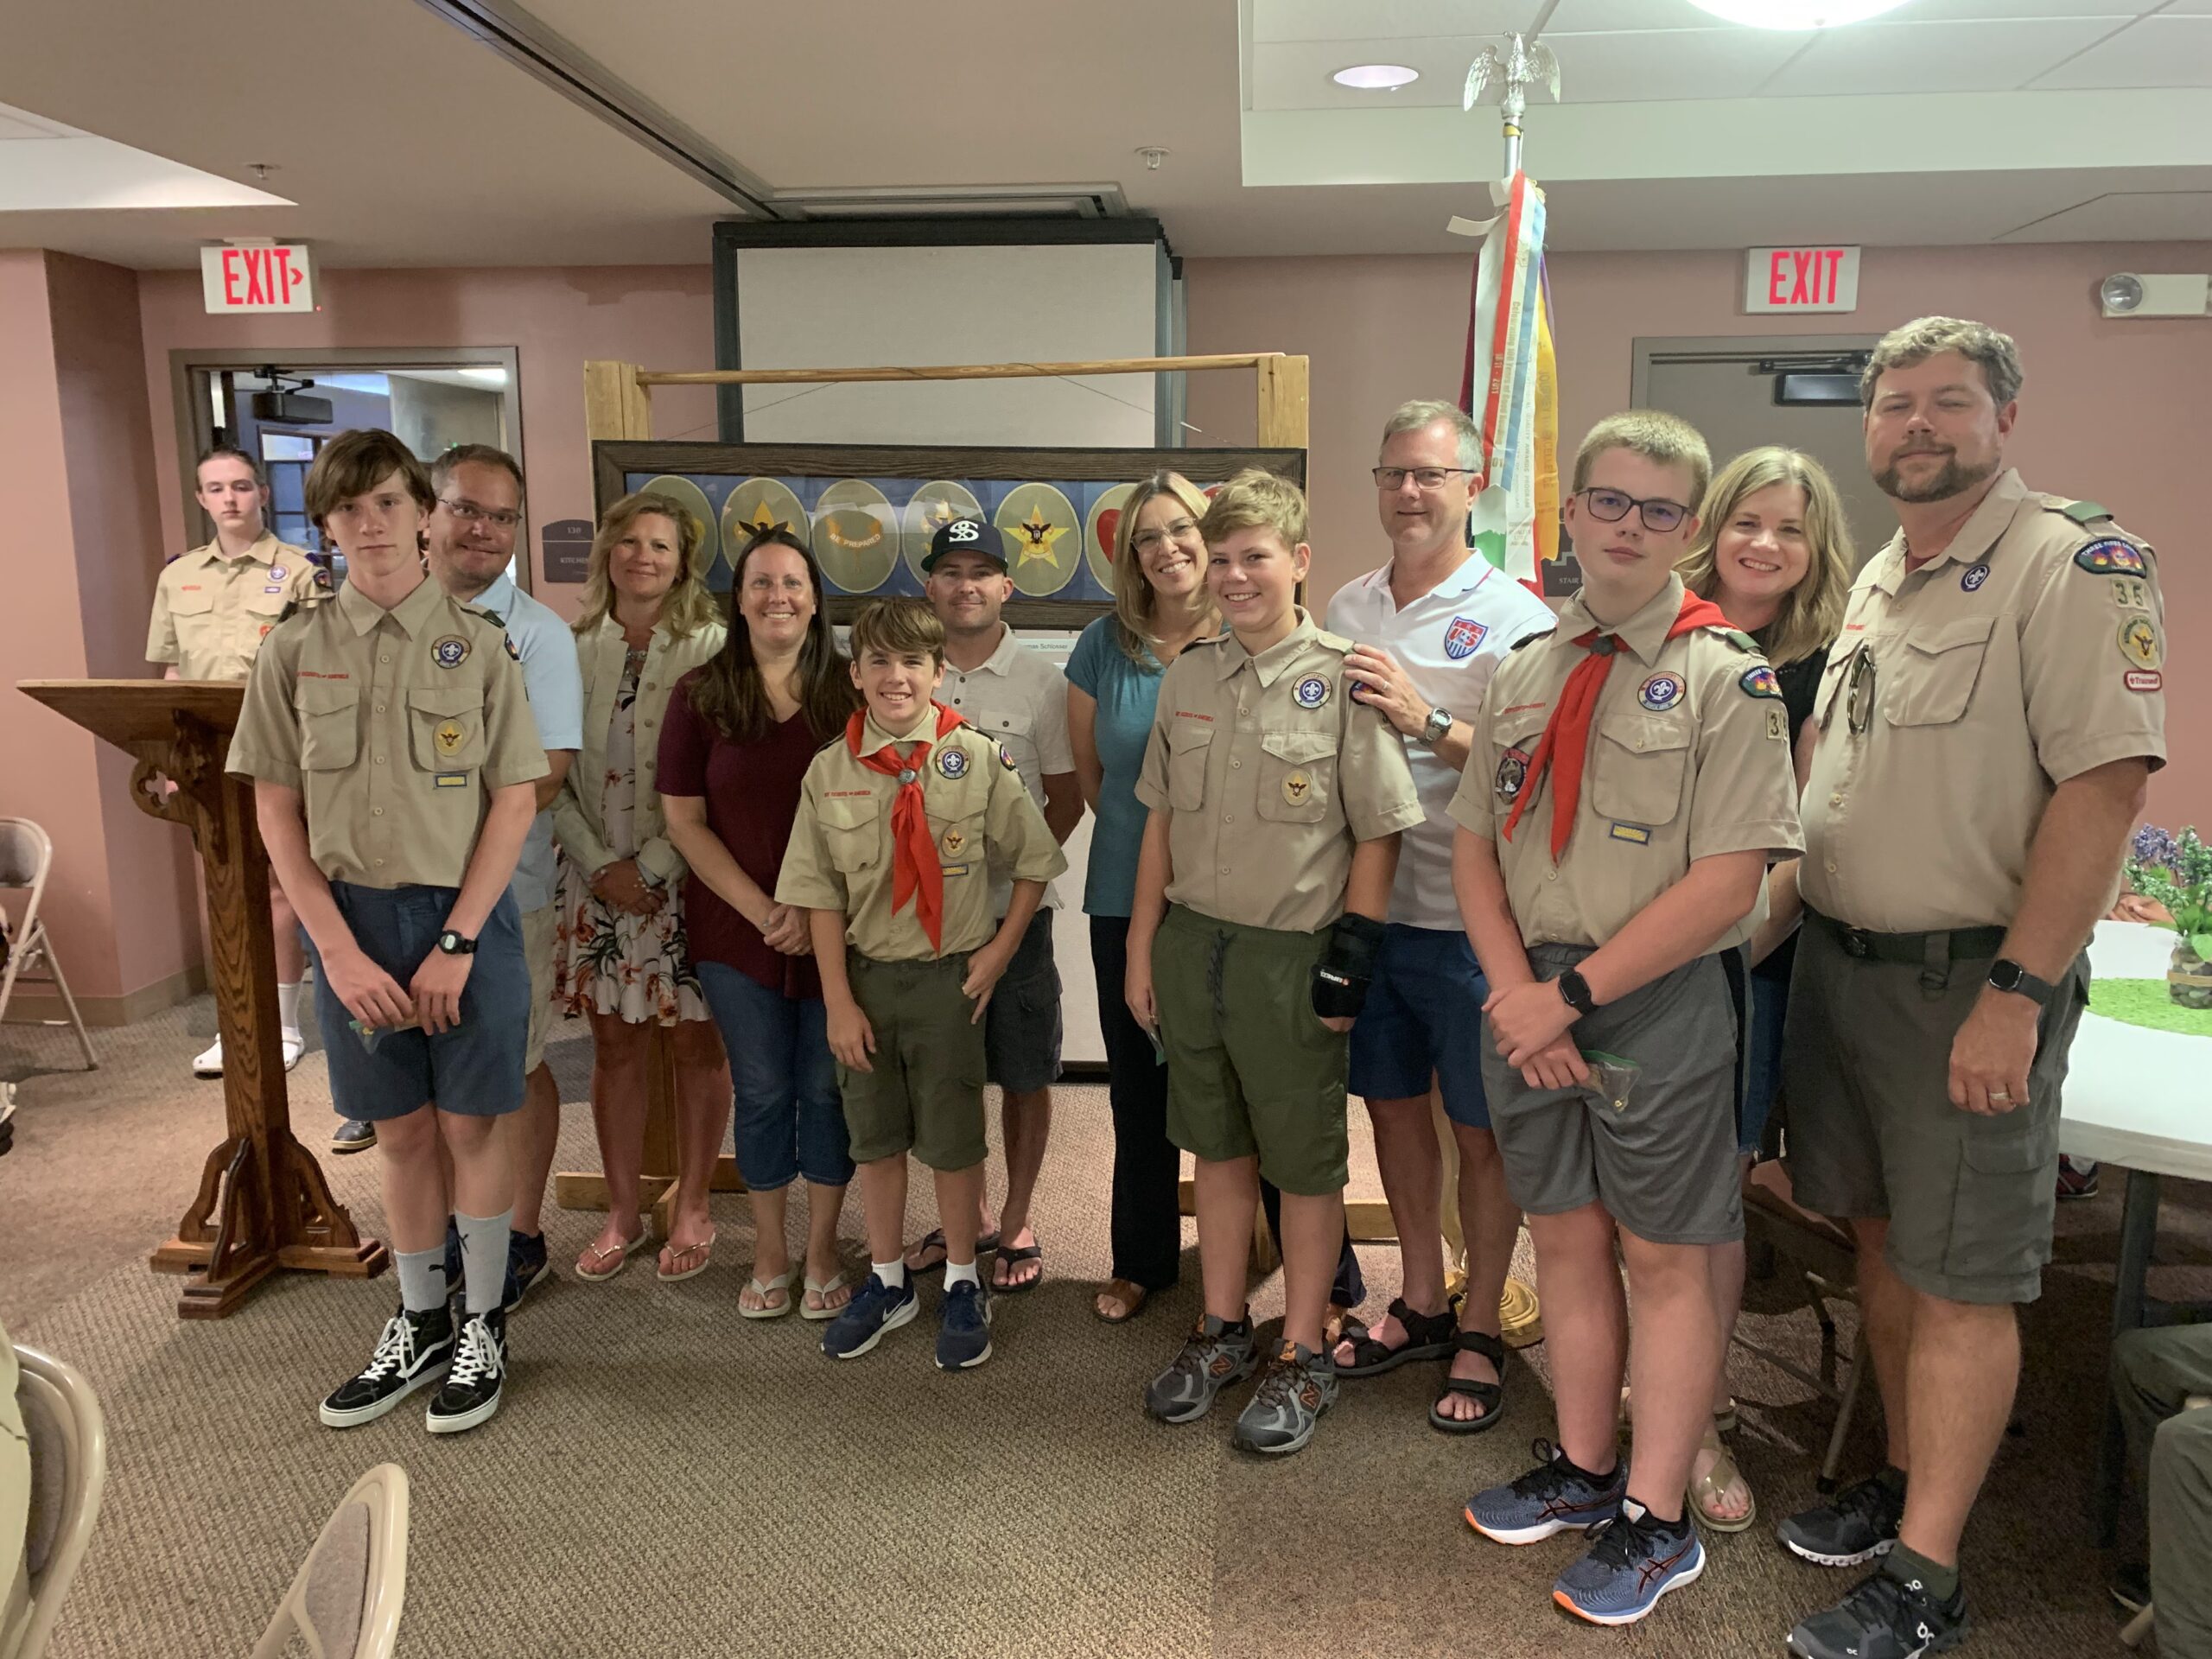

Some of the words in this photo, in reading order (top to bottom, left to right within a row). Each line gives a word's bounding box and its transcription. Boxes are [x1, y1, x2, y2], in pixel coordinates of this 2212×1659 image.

[222, 248, 291, 305] EXIT
[1769, 250, 1844, 305] EXIT
[843, 533, 880, 548] PREPARED
[2114, 582, 2144, 607] 35
